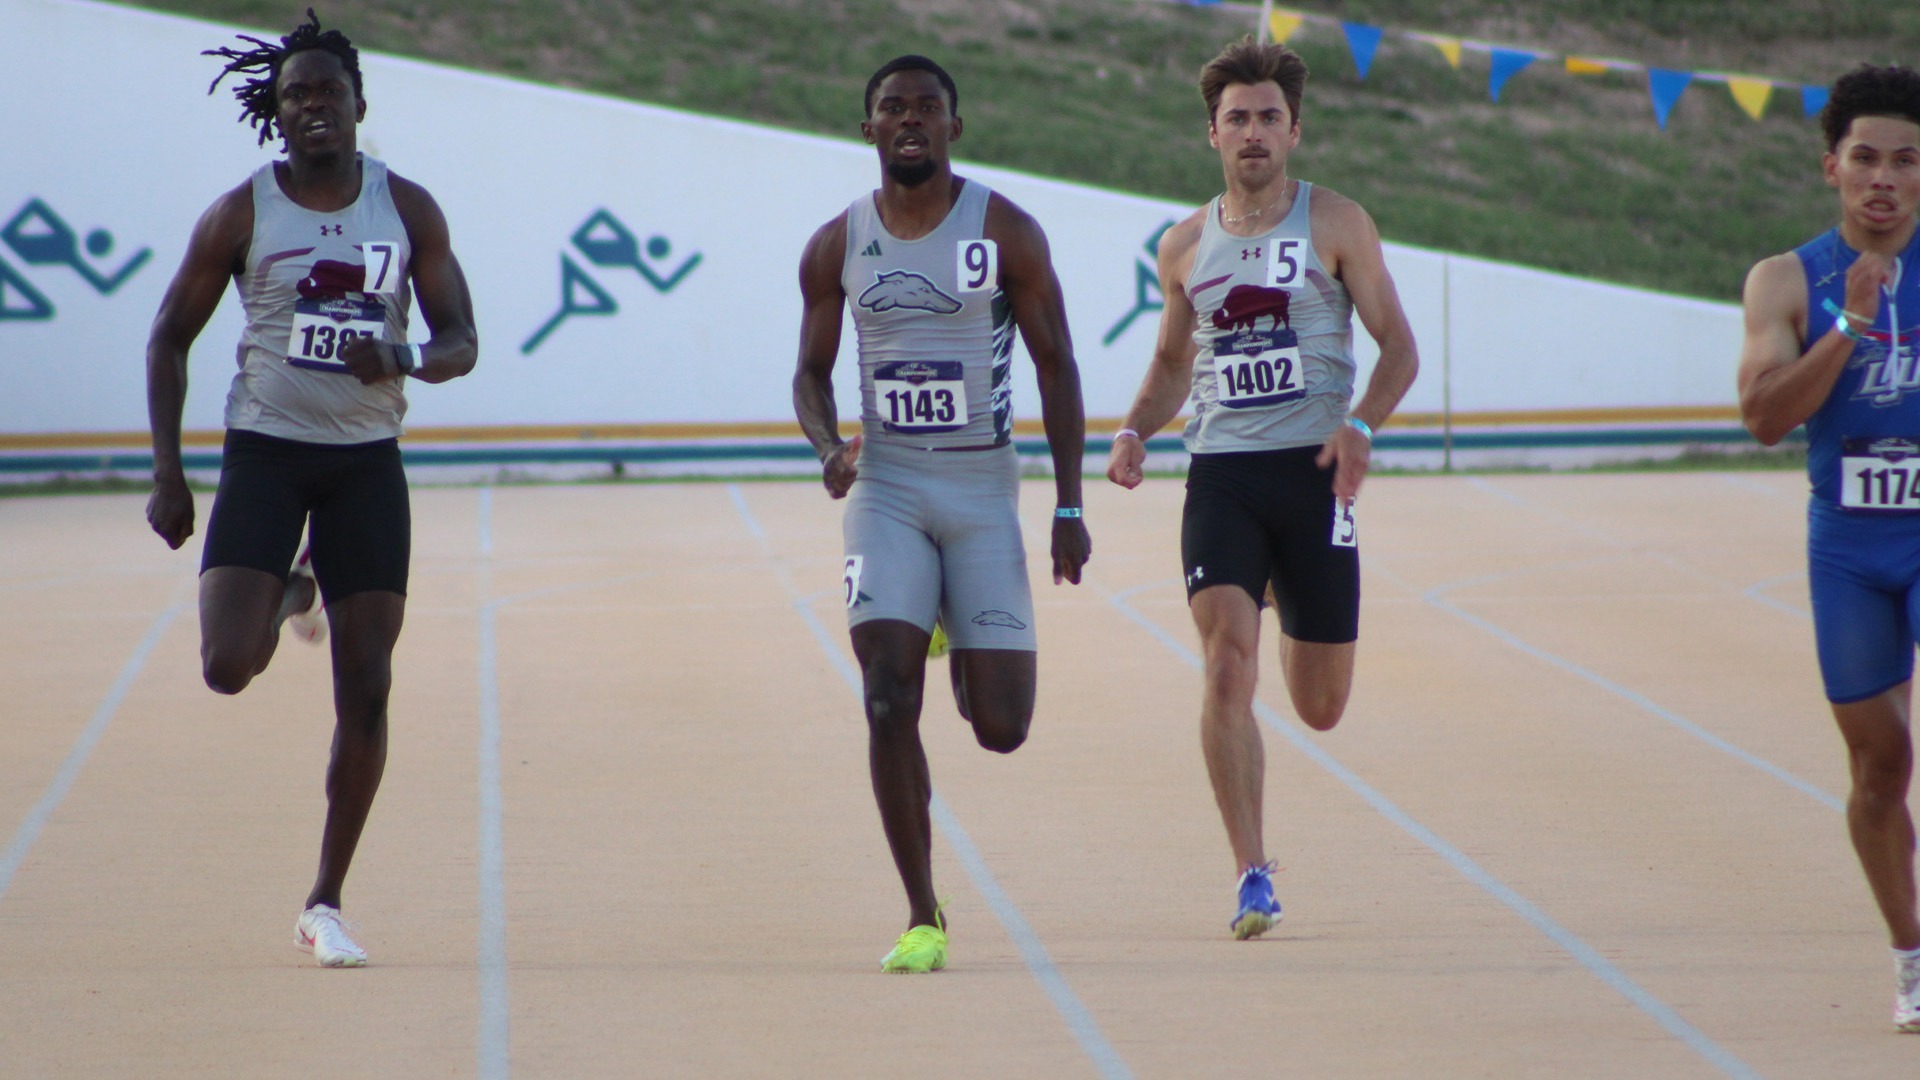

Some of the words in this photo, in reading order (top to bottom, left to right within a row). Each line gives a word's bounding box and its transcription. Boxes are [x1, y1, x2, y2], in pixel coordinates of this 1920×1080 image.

[371, 245, 392, 290] 7
[965, 242, 989, 288] 9
[1275, 241, 1299, 284] 5
[300, 324, 374, 361] 138
[1221, 357, 1295, 397] 1402
[885, 389, 956, 423] 1143
[1856, 467, 1920, 505] 1174
